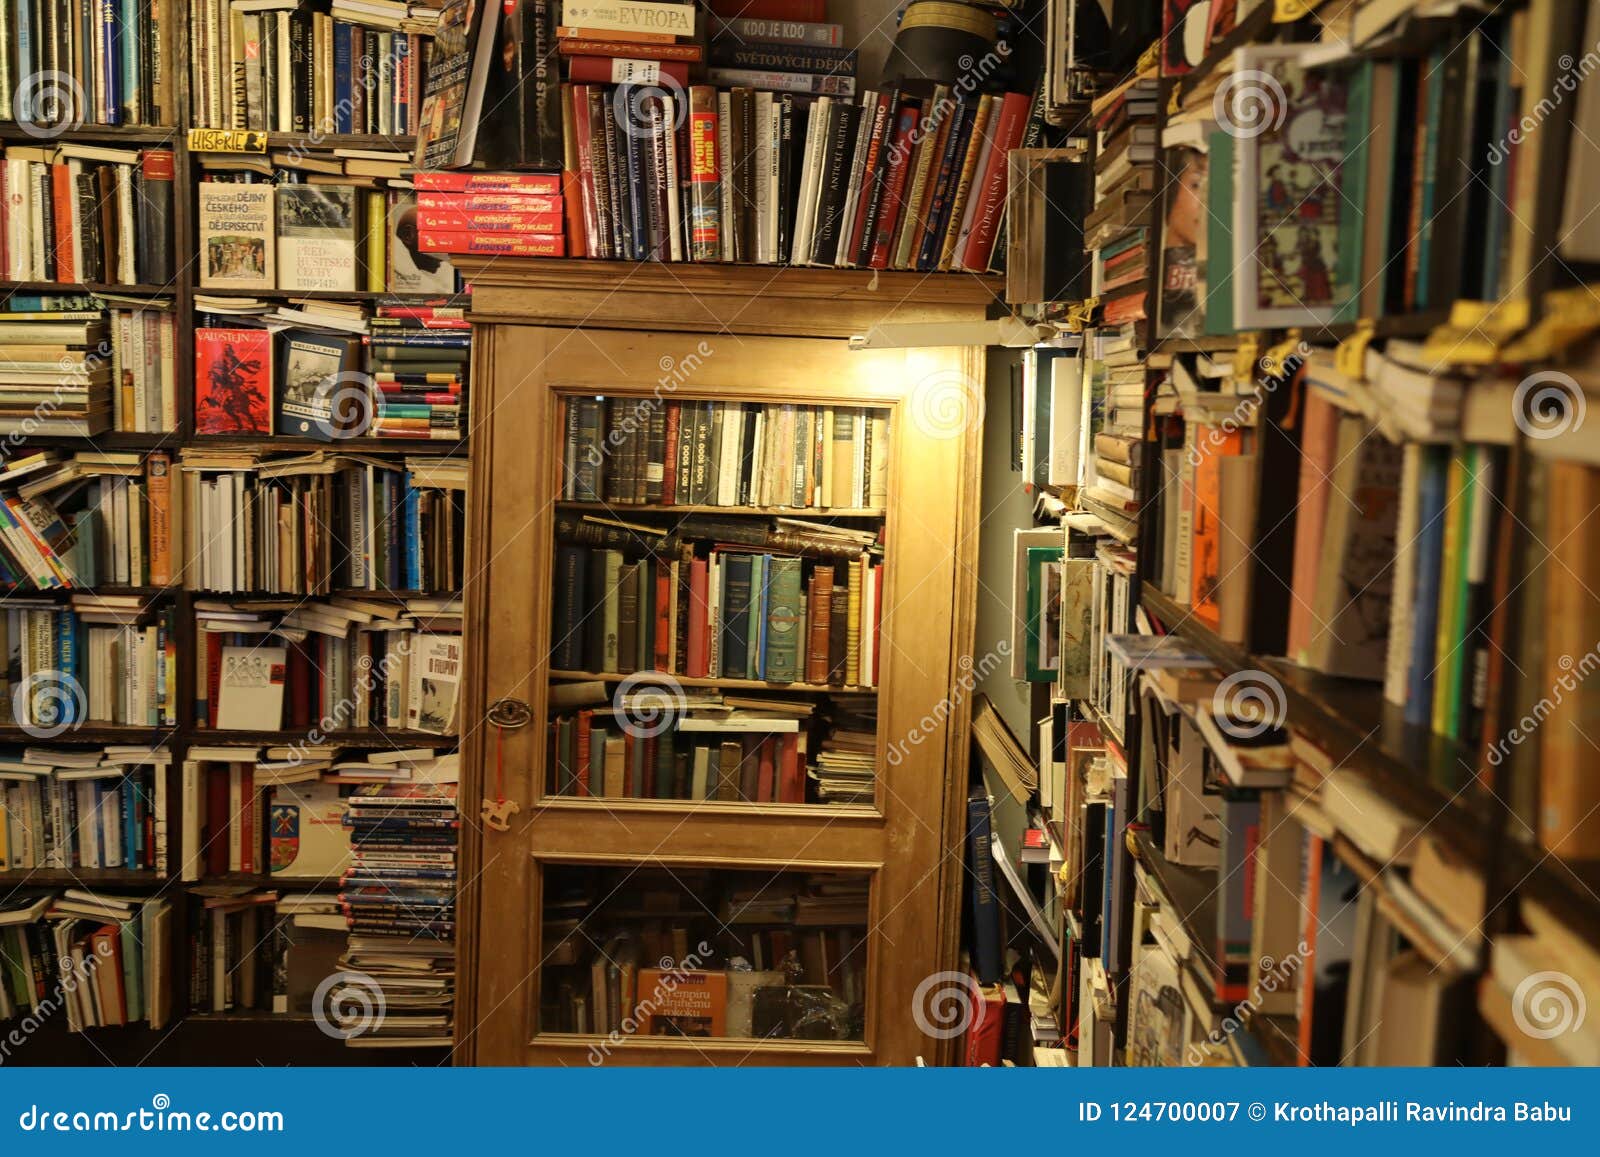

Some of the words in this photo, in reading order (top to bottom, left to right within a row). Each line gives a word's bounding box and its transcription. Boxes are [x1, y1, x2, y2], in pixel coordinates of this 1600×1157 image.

[619, 7, 690, 29] EVROPA
[743, 21, 766, 36] KDO
[768, 22, 780, 37] JE
[782, 23, 805, 39] KDO
[535, 18, 546, 78] ROLLING
[735, 51, 811, 69] SVĚTOVÝCH
[693, 120, 705, 175] Kronika
[704, 140, 715, 174] Země
[237, 192, 267, 203] DĚJINY
[206, 203, 248, 213] ČESKÉHO
[208, 220, 265, 232] DĚJEPISECTVÍ
